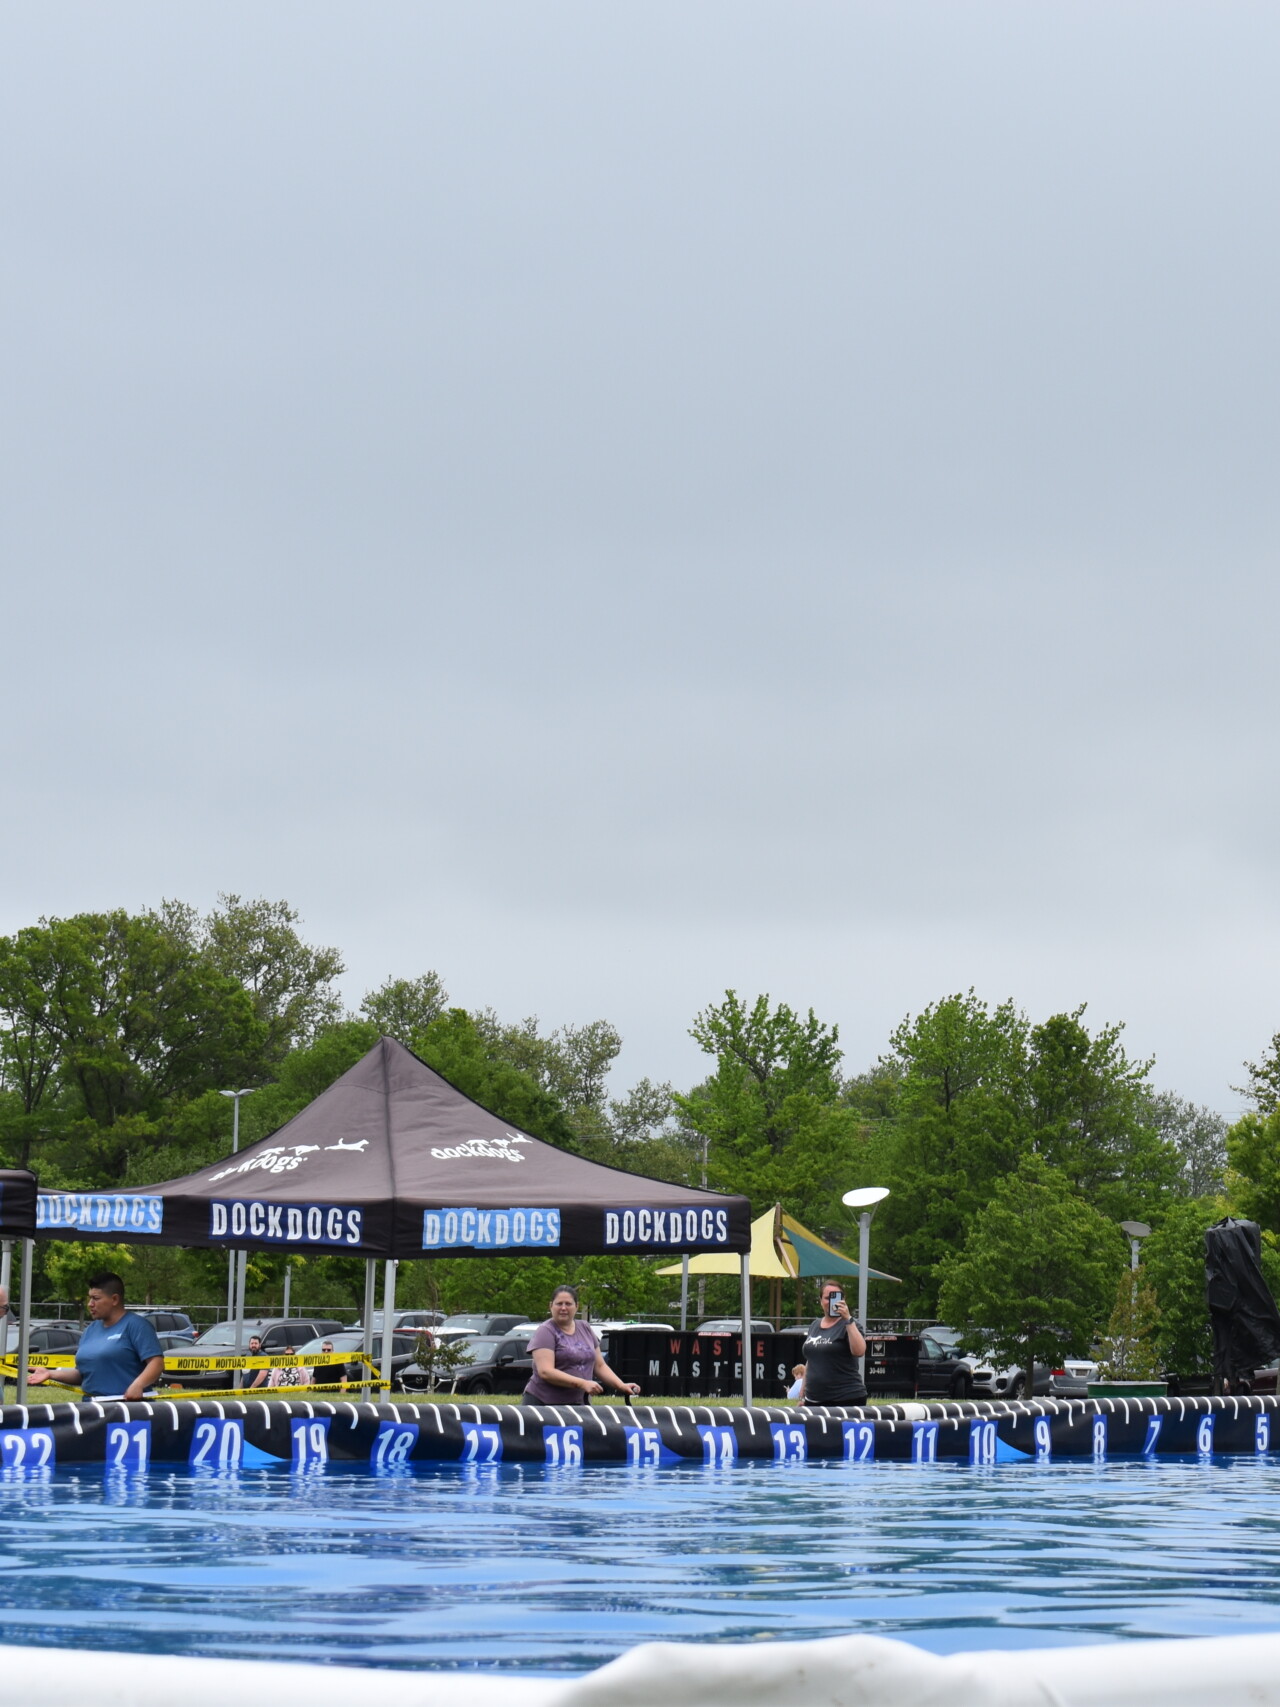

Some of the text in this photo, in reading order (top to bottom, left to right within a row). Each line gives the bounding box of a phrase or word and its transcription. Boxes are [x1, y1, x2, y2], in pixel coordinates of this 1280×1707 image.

[212, 1202, 361, 1243] DOCKDOGS
[426, 1211, 559, 1245] DOCKDOGS
[606, 1209, 727, 1244] DOCKDOGS
[670, 1340, 764, 1356] WASTE
[649, 1360, 786, 1379] MASTERS
[4, 1433, 52, 1466] 22
[110, 1428, 147, 1466] 21
[194, 1421, 242, 1466] 20
[293, 1423, 326, 1463] 19
[376, 1428, 414, 1463] 18
[465, 1430, 499, 1463] 17
[546, 1429, 580, 1464] 16
[628, 1431, 660, 1463] 15
[703, 1431, 734, 1464] 14
[774, 1429, 805, 1461] 13
[844, 1427, 872, 1460] 12
[915, 1426, 937, 1461] 11
[971, 1423, 996, 1463] 10
[1036, 1420, 1050, 1457] 9
[1093, 1421, 1105, 1454] 8
[1144, 1420, 1160, 1454] 7
[1199, 1417, 1212, 1452] 6
[1257, 1416, 1268, 1451] 5
